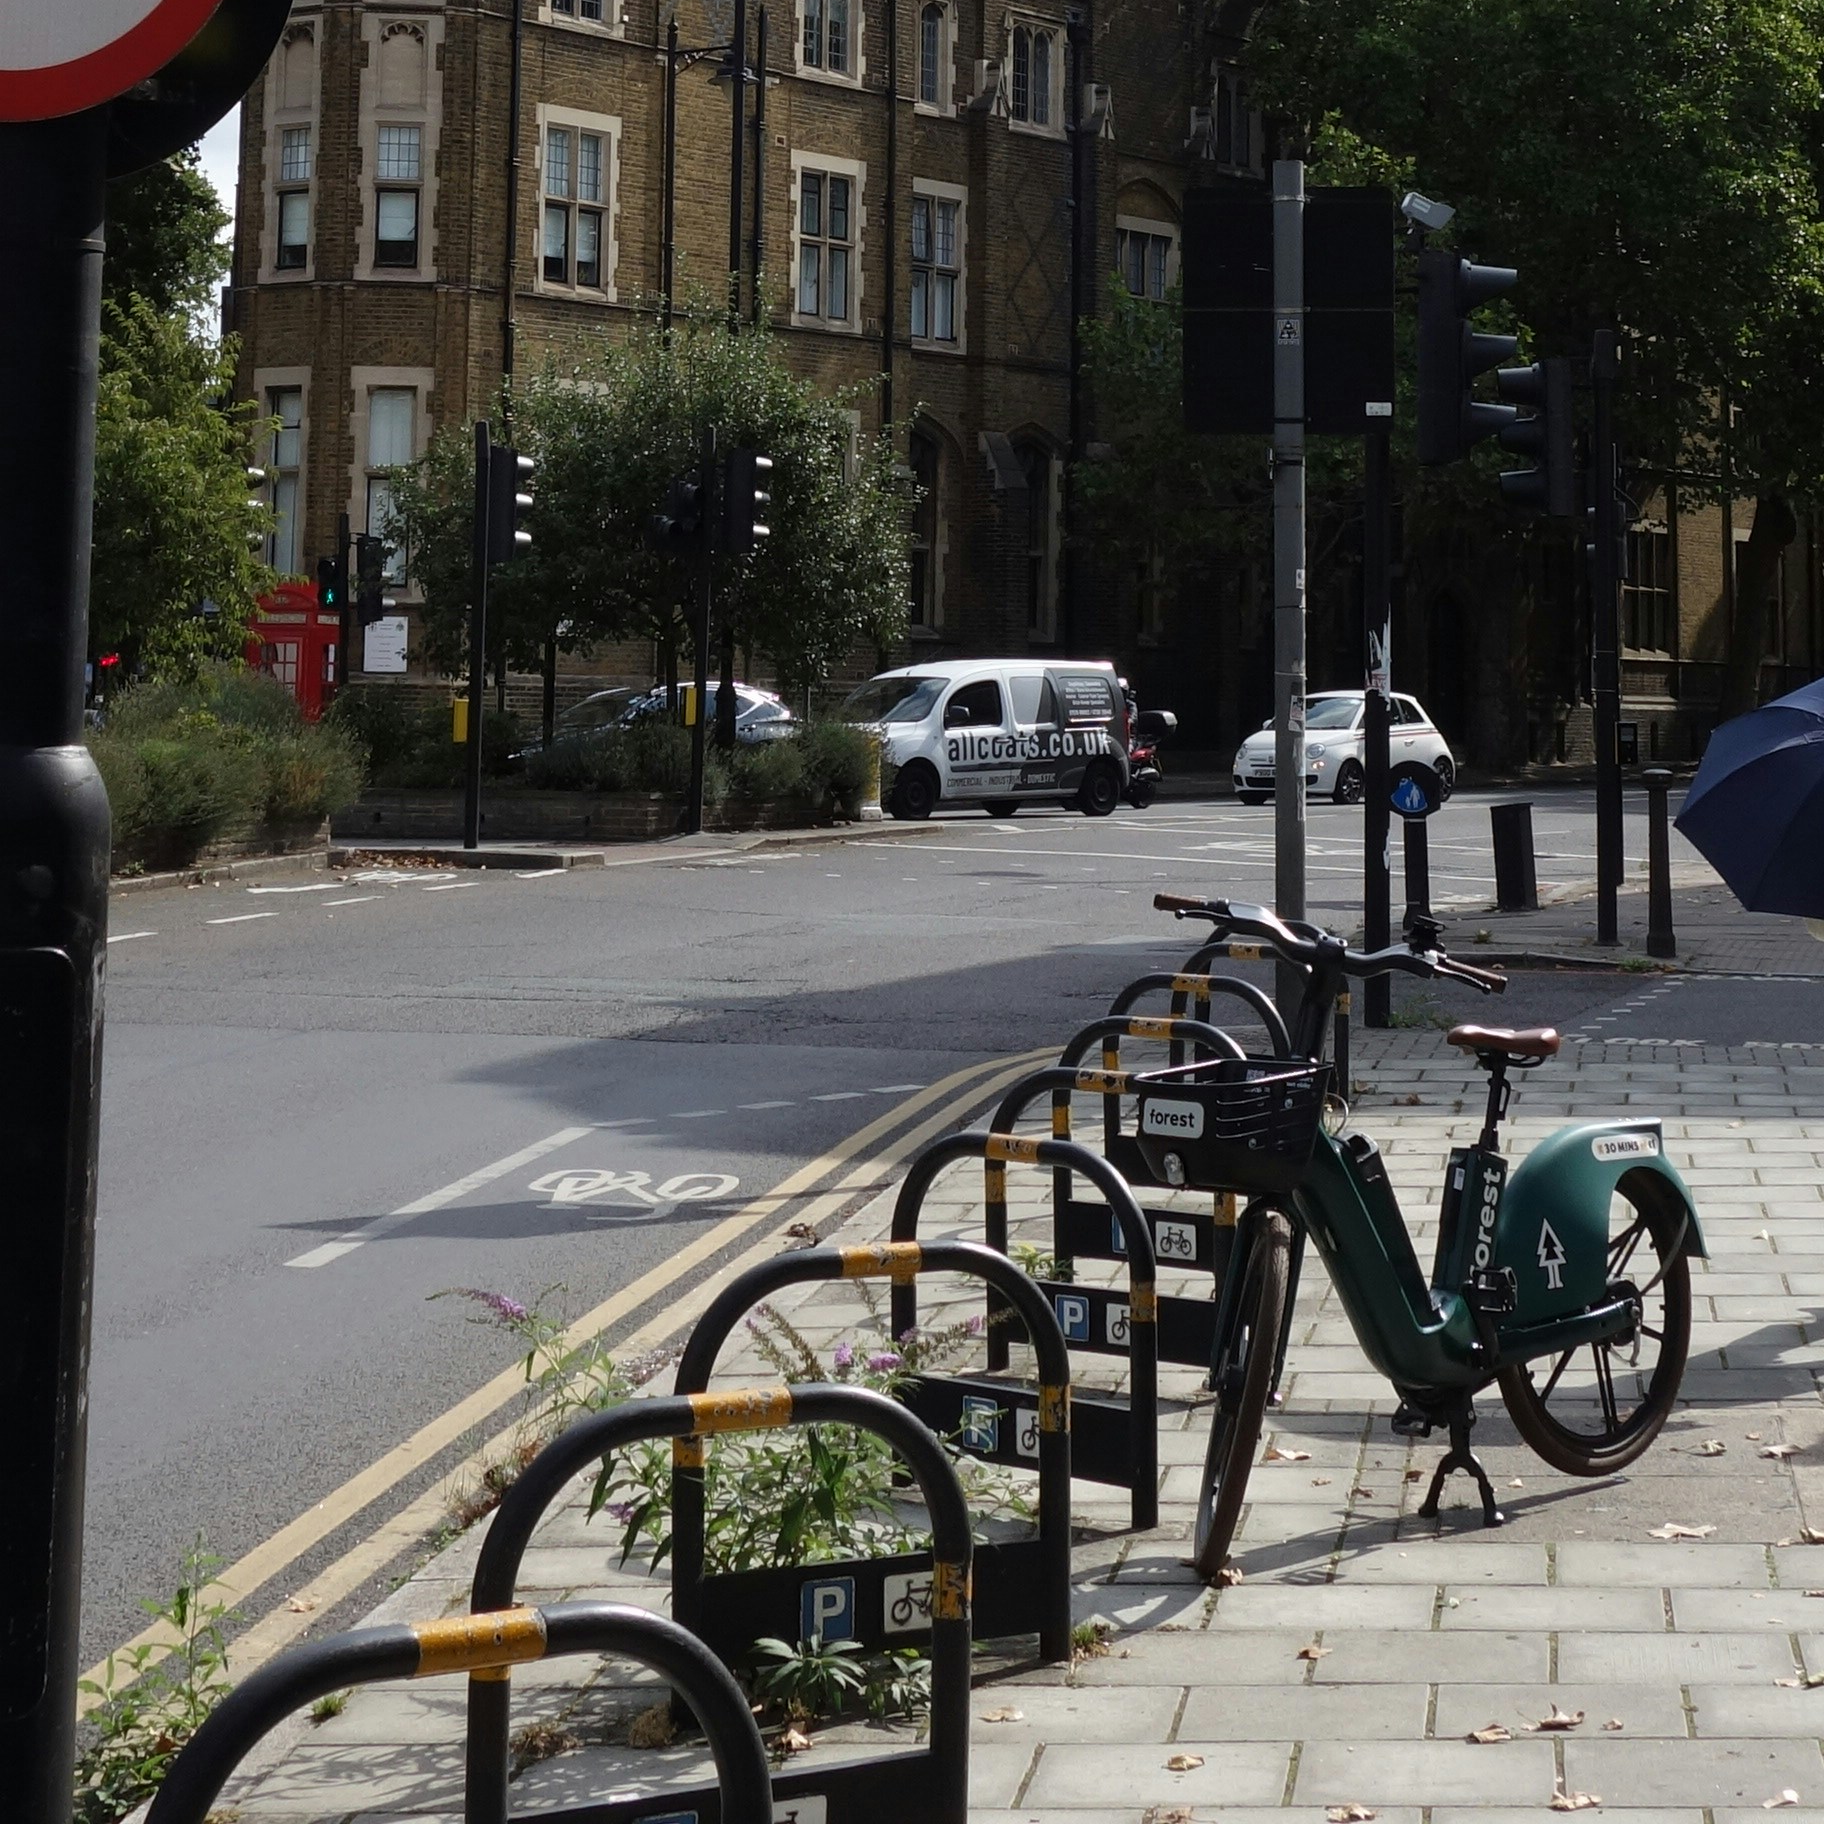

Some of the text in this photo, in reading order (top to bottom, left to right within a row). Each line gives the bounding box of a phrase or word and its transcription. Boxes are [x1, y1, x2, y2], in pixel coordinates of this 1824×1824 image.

[948, 732, 1111, 761] allcoats.co.uk
[947, 773, 1056, 788] COMMERCIAL INDUSTRIAL DOMESTIC
[1149, 1108, 1195, 1128] forest
[1604, 1142, 1616, 1154] 30
[1617, 1140, 1640, 1153] MINS
[1063, 1301, 1083, 1336] P
[814, 1586, 845, 1643] P
